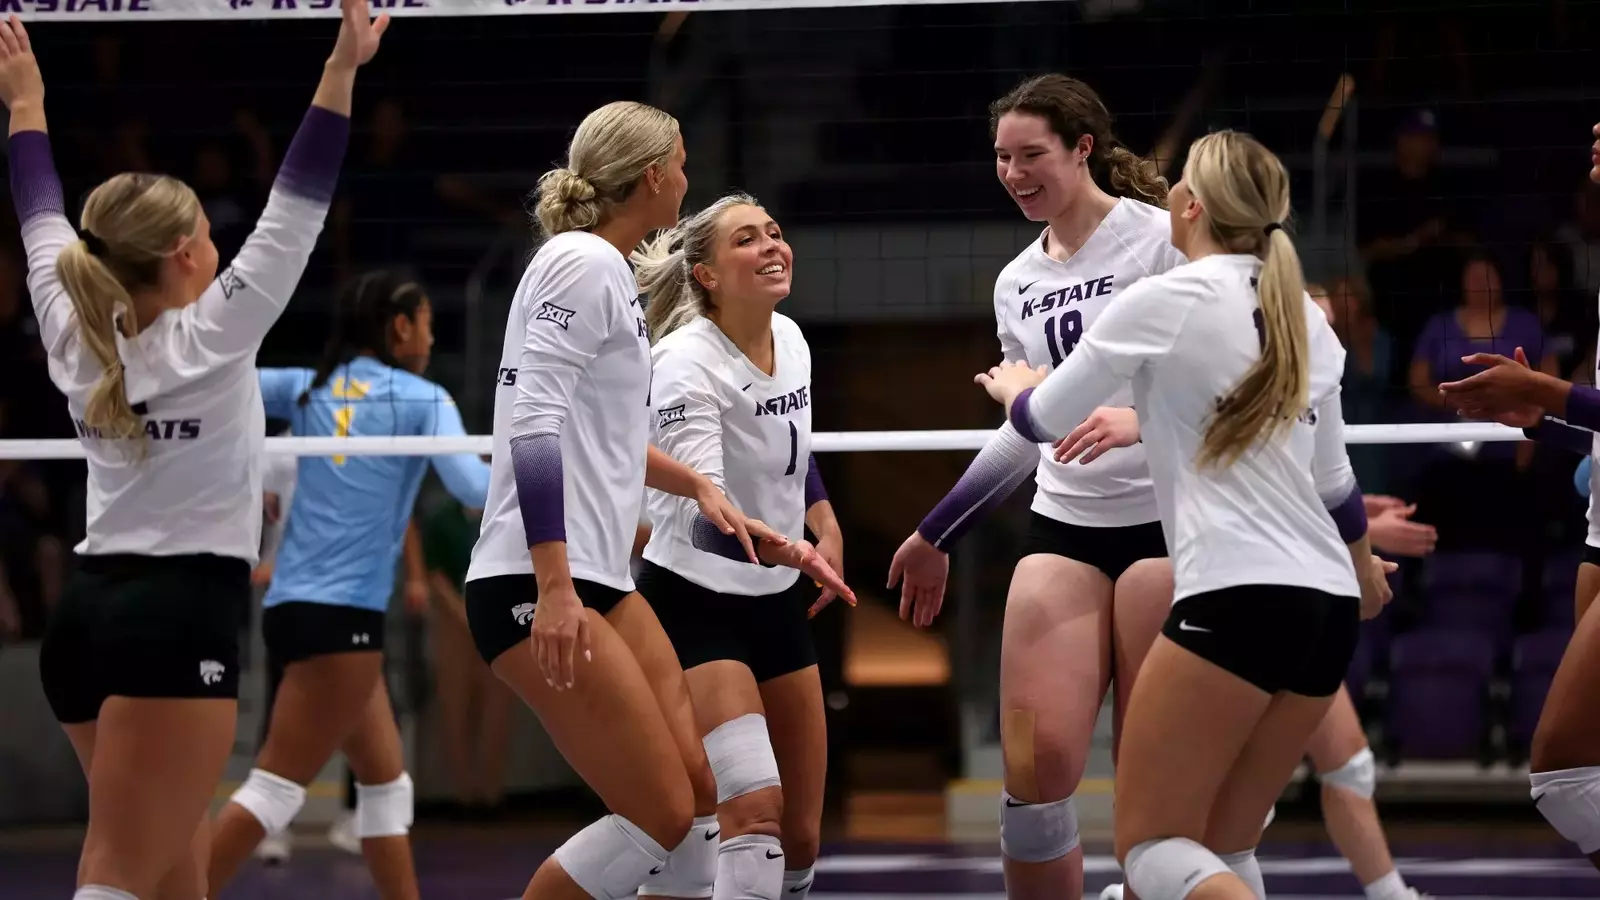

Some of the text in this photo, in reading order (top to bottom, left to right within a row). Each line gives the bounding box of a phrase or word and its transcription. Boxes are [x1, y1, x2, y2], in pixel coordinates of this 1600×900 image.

[1021, 275, 1114, 320] K-STATE
[1044, 309, 1083, 370] 18
[755, 386, 808, 416] KSTATE
[784, 420, 798, 476] 1
